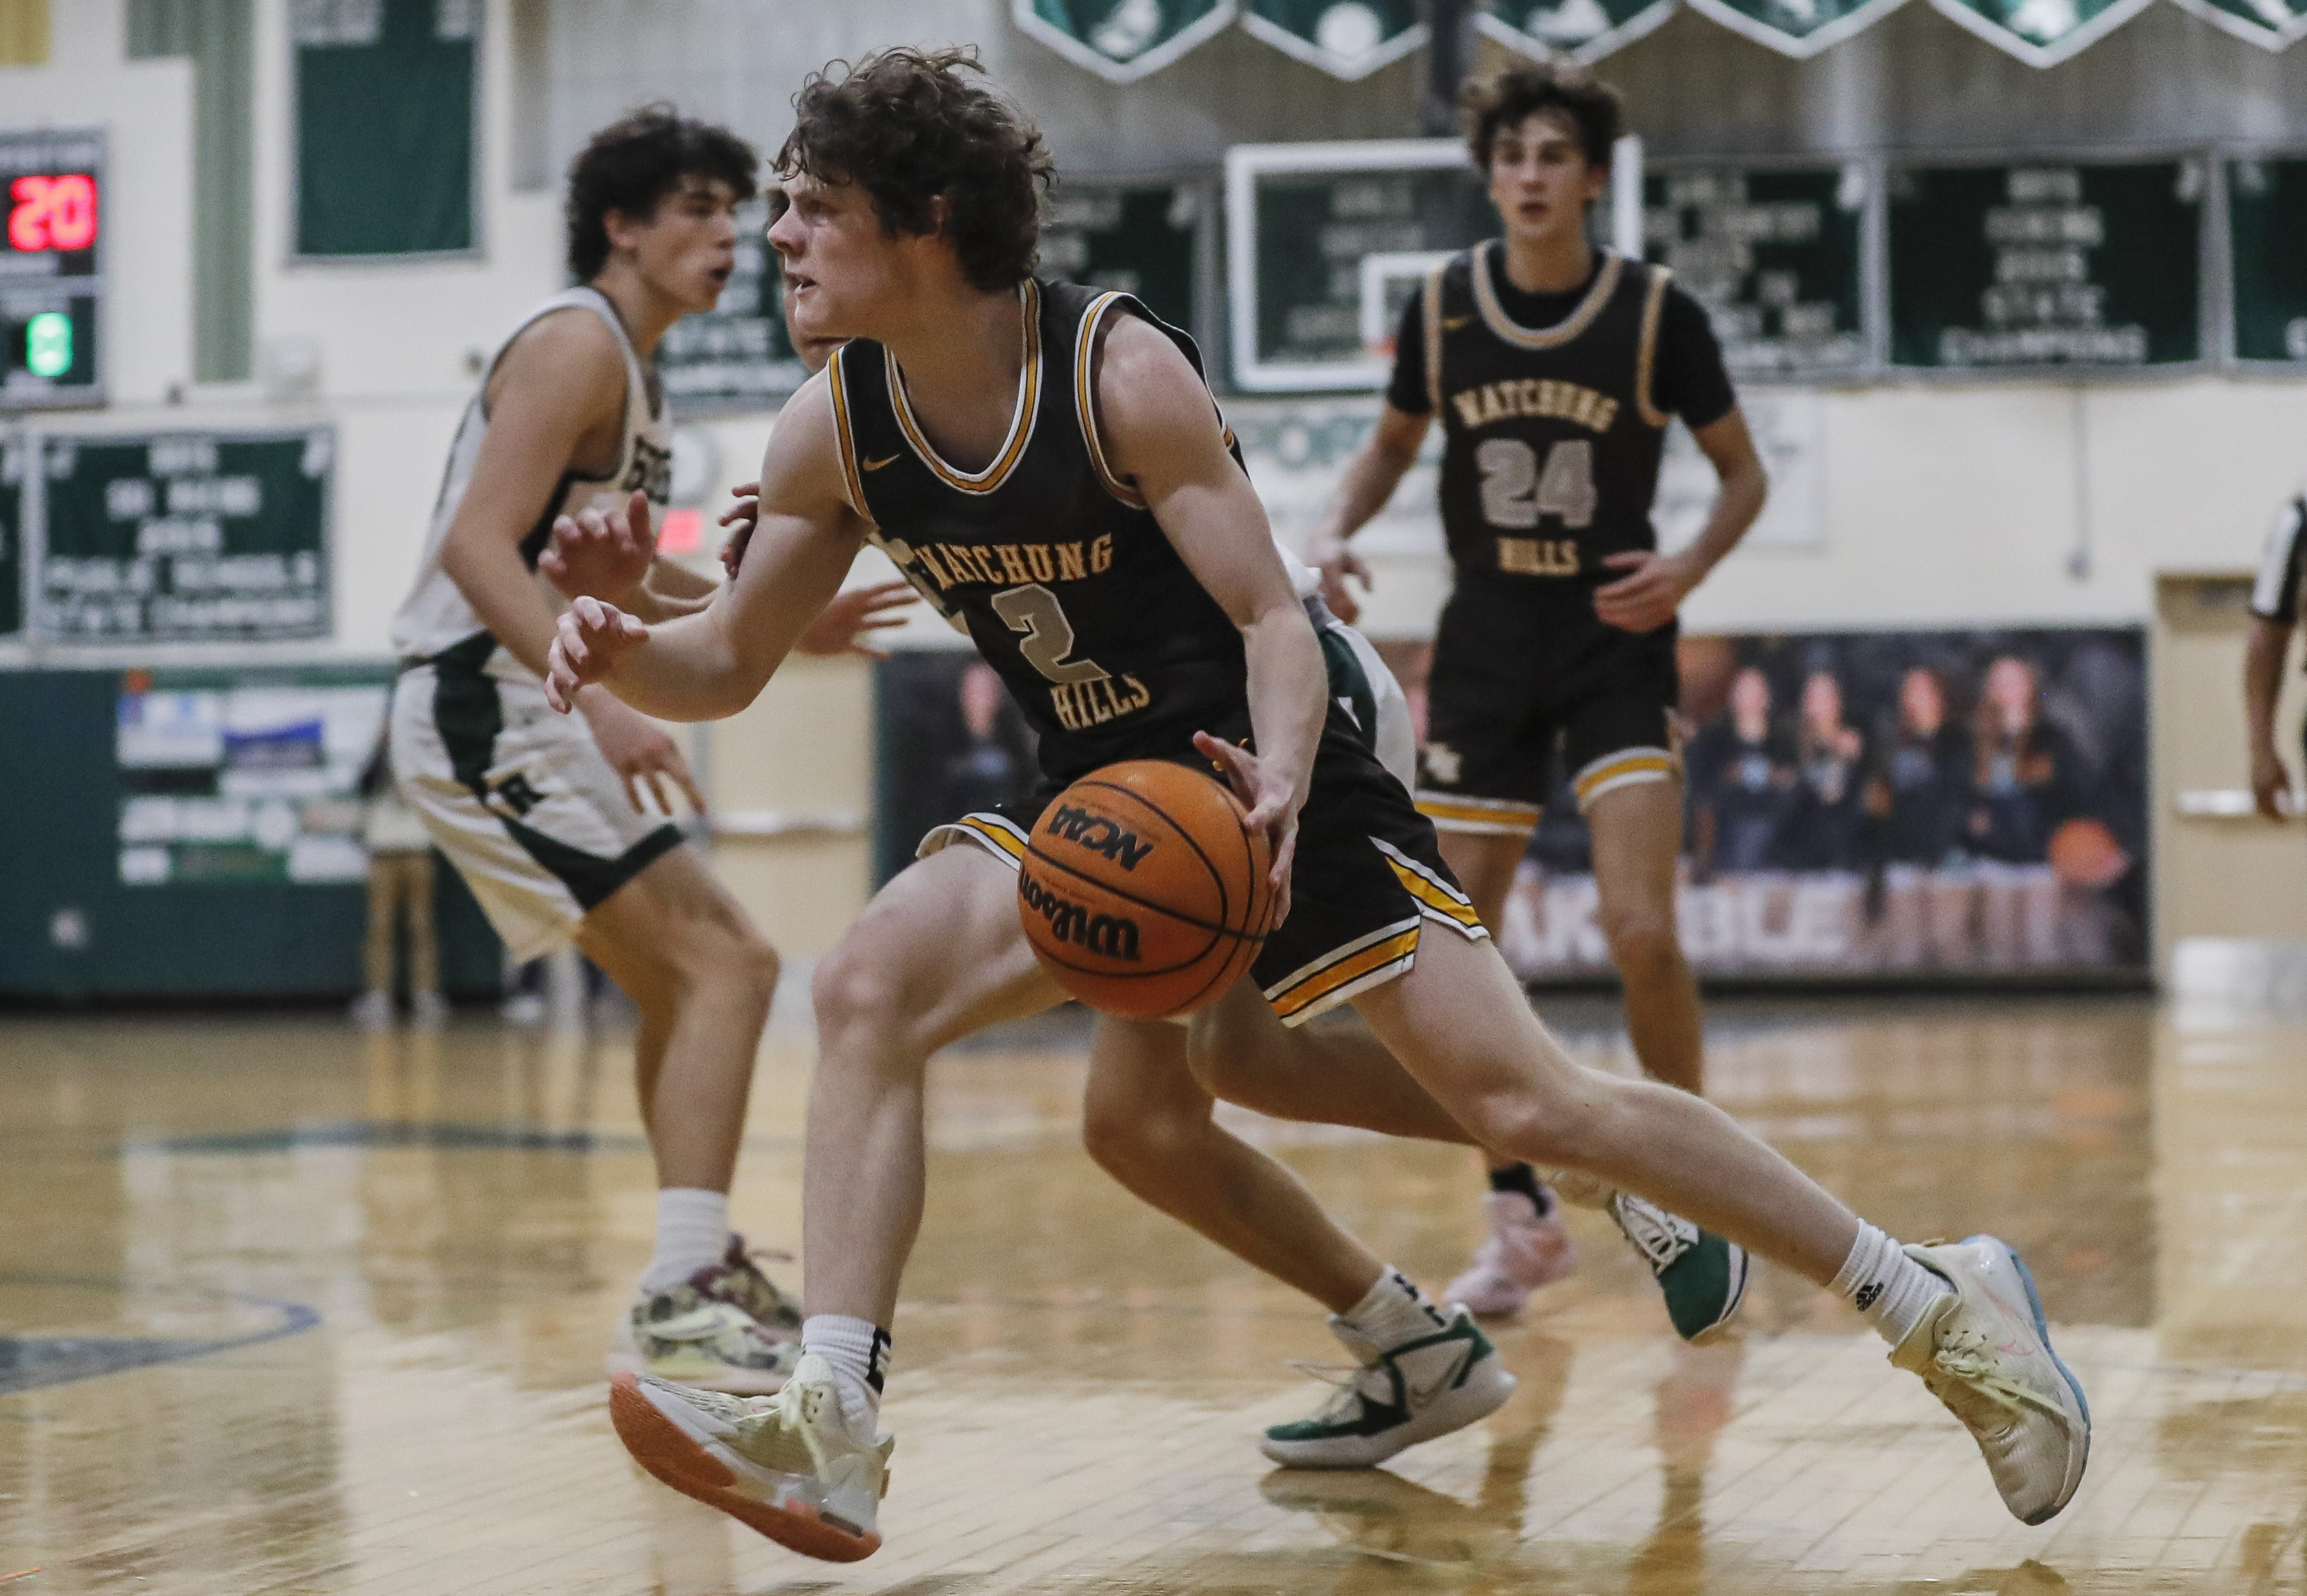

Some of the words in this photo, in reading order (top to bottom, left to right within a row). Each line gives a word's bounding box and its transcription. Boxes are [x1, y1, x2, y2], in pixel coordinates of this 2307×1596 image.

[9, 175, 97, 251] 20
[1474, 438, 1597, 528] 24
[1497, 536, 1581, 576] HILLS
[991, 583, 1112, 684] 2
[1050, 673, 1150, 730] HILLS
[1048, 804, 1155, 872] NCAA
[1018, 866, 1141, 962] Wilson
